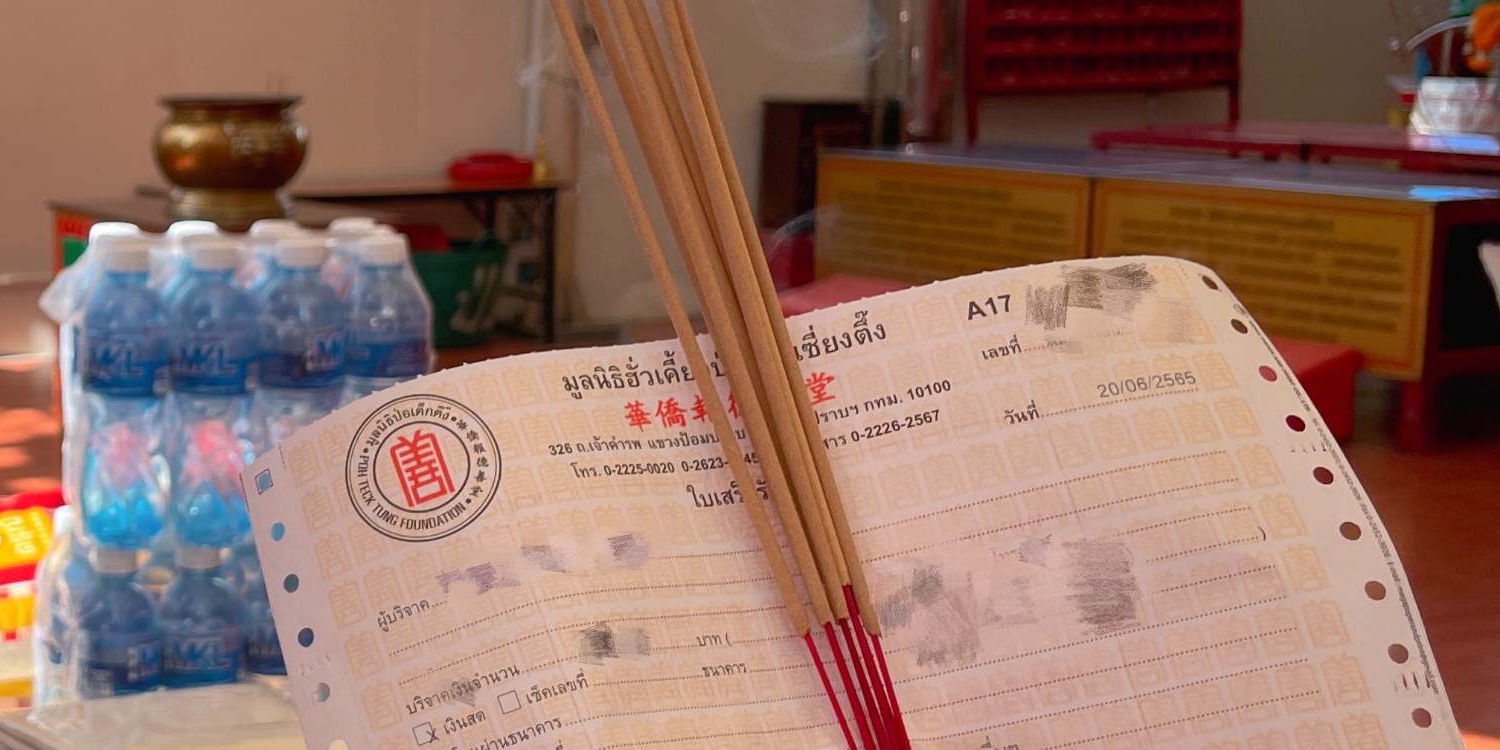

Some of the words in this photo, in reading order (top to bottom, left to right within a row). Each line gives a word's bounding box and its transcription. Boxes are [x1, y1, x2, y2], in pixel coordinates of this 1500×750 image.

[967, 294, 1011, 321] A17
[982, 335, 1022, 360] เลขที่
[1097, 370, 1197, 398] 20/06/2565
[548, 441, 573, 456] 326
[864, 393, 904, 412] กทม.
[907, 379, 952, 401] 10100
[1003, 400, 1040, 425] วันที่
[570, 461, 602, 479] โทร.
[604, 463, 675, 477] 0-2225-0020
[851, 409, 941, 443] 0-2226-2567
[357, 455, 370, 477] POH
[358, 478, 377, 506] TECK
[373, 502, 399, 526] TUNG
[400, 502, 466, 530] FOUNDATION
[377, 599, 430, 632] ผู้บริจาค
[696, 633, 722, 648] บาท
[701, 662, 747, 678] ธนาคาร
[525, 668, 589, 705] เช็คเลขที่
[443, 710, 486, 735] เงินสด
